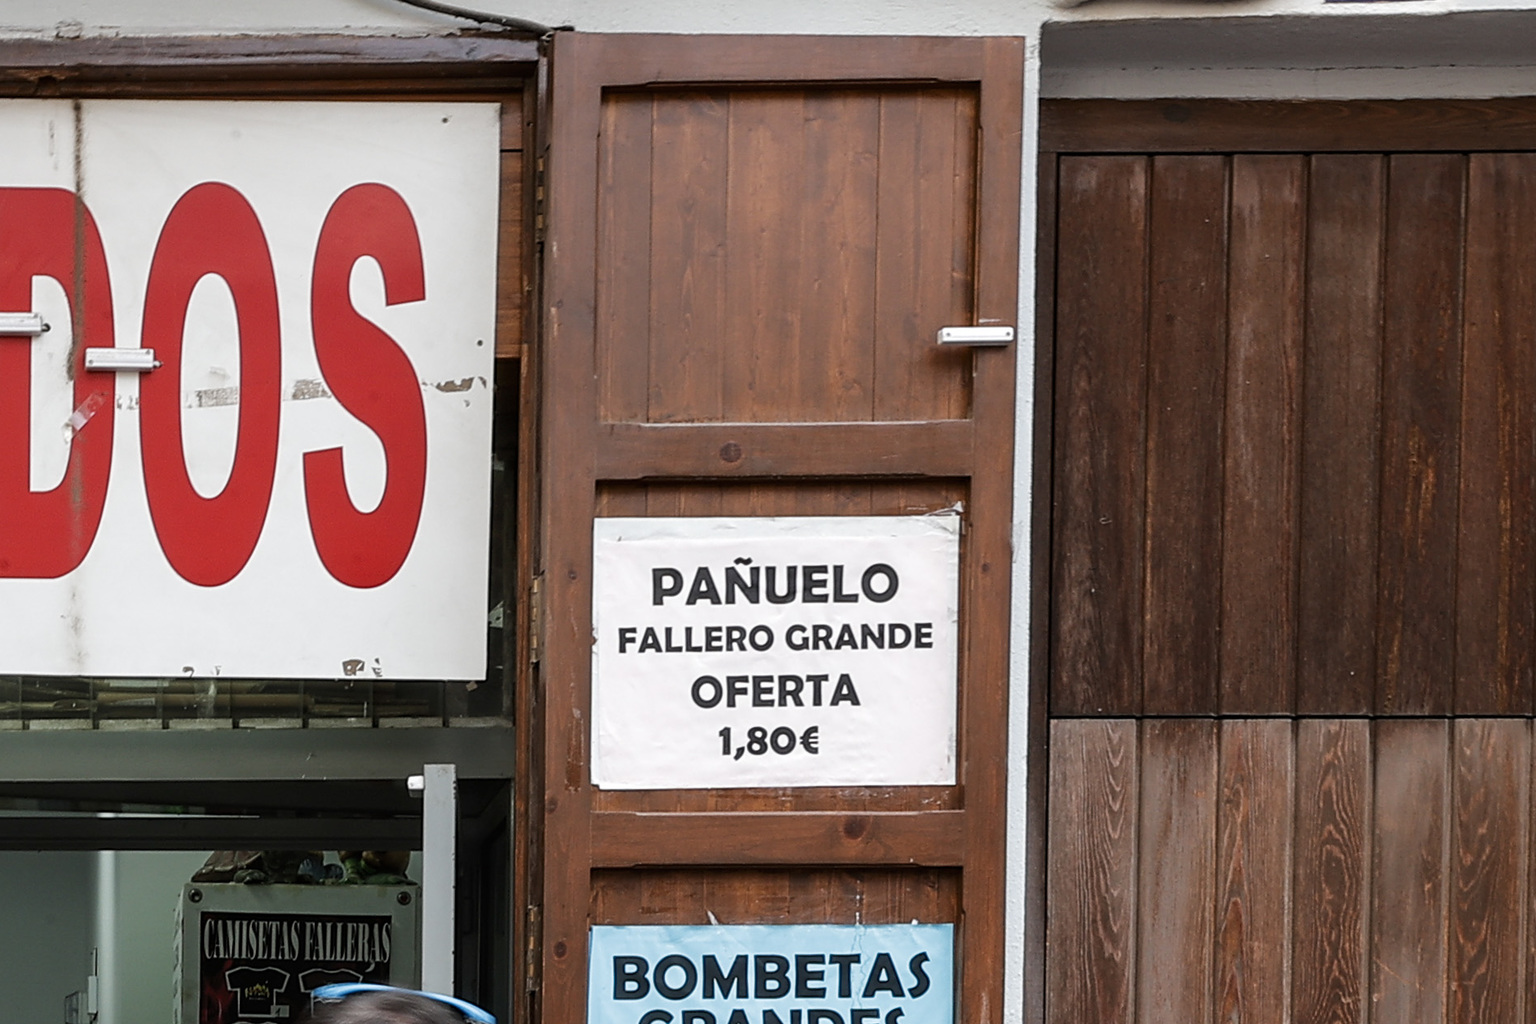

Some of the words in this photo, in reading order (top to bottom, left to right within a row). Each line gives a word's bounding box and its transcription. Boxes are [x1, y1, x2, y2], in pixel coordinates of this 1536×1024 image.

[651, 556, 900, 606] PAÑUELO
[618, 624, 774, 654] FALLERO
[785, 622, 934, 652] GRANDE
[691, 673, 861, 709] OFERTA
[718, 725, 820, 761] 1,80€
[203, 918, 300, 961] CAMISETAS
[304, 921, 391, 965] FALLERAS
[612, 951, 931, 1001] BOMBETAS
